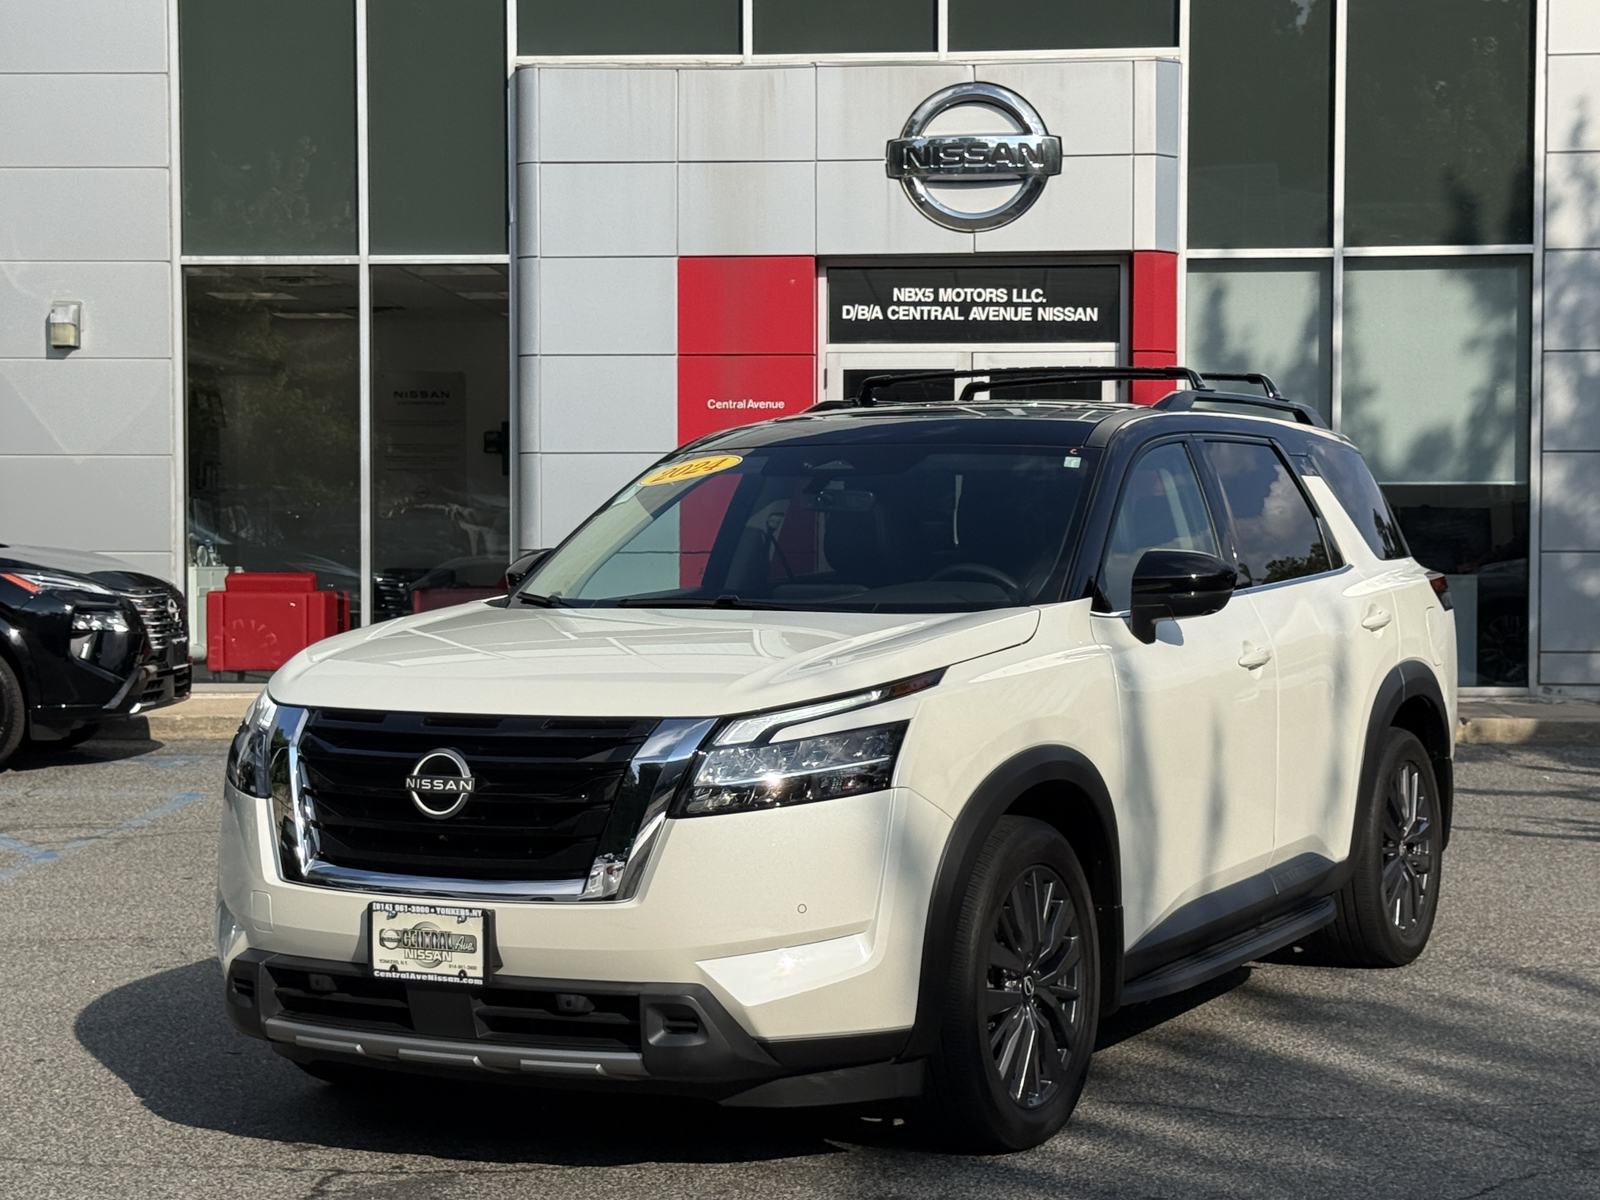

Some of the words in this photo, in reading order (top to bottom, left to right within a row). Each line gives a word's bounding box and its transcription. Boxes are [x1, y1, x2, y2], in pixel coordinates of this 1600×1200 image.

[902, 143, 1044, 170] NISSAN
[892, 287, 934, 302] NBX5
[938, 288, 1008, 303] MOTORS
[1012, 289, 1047, 303] LLC.
[841, 304, 884, 321] D/B/A
[887, 306, 964, 321] CENTRAL
[968, 307, 1032, 321] AVENUE
[1037, 307, 1098, 322] NISSAN
[393, 390, 451, 399] NISSAN
[707, 399, 746, 409] Central
[747, 399, 785, 409] Avenue
[649, 457, 729, 483] 2024
[405, 777, 473, 791] NISSAN
[402, 928, 454, 950] CENTRAL
[404, 949, 453, 962] NISSAN
[374, 970, 484, 985] CentralAveNissan.com
